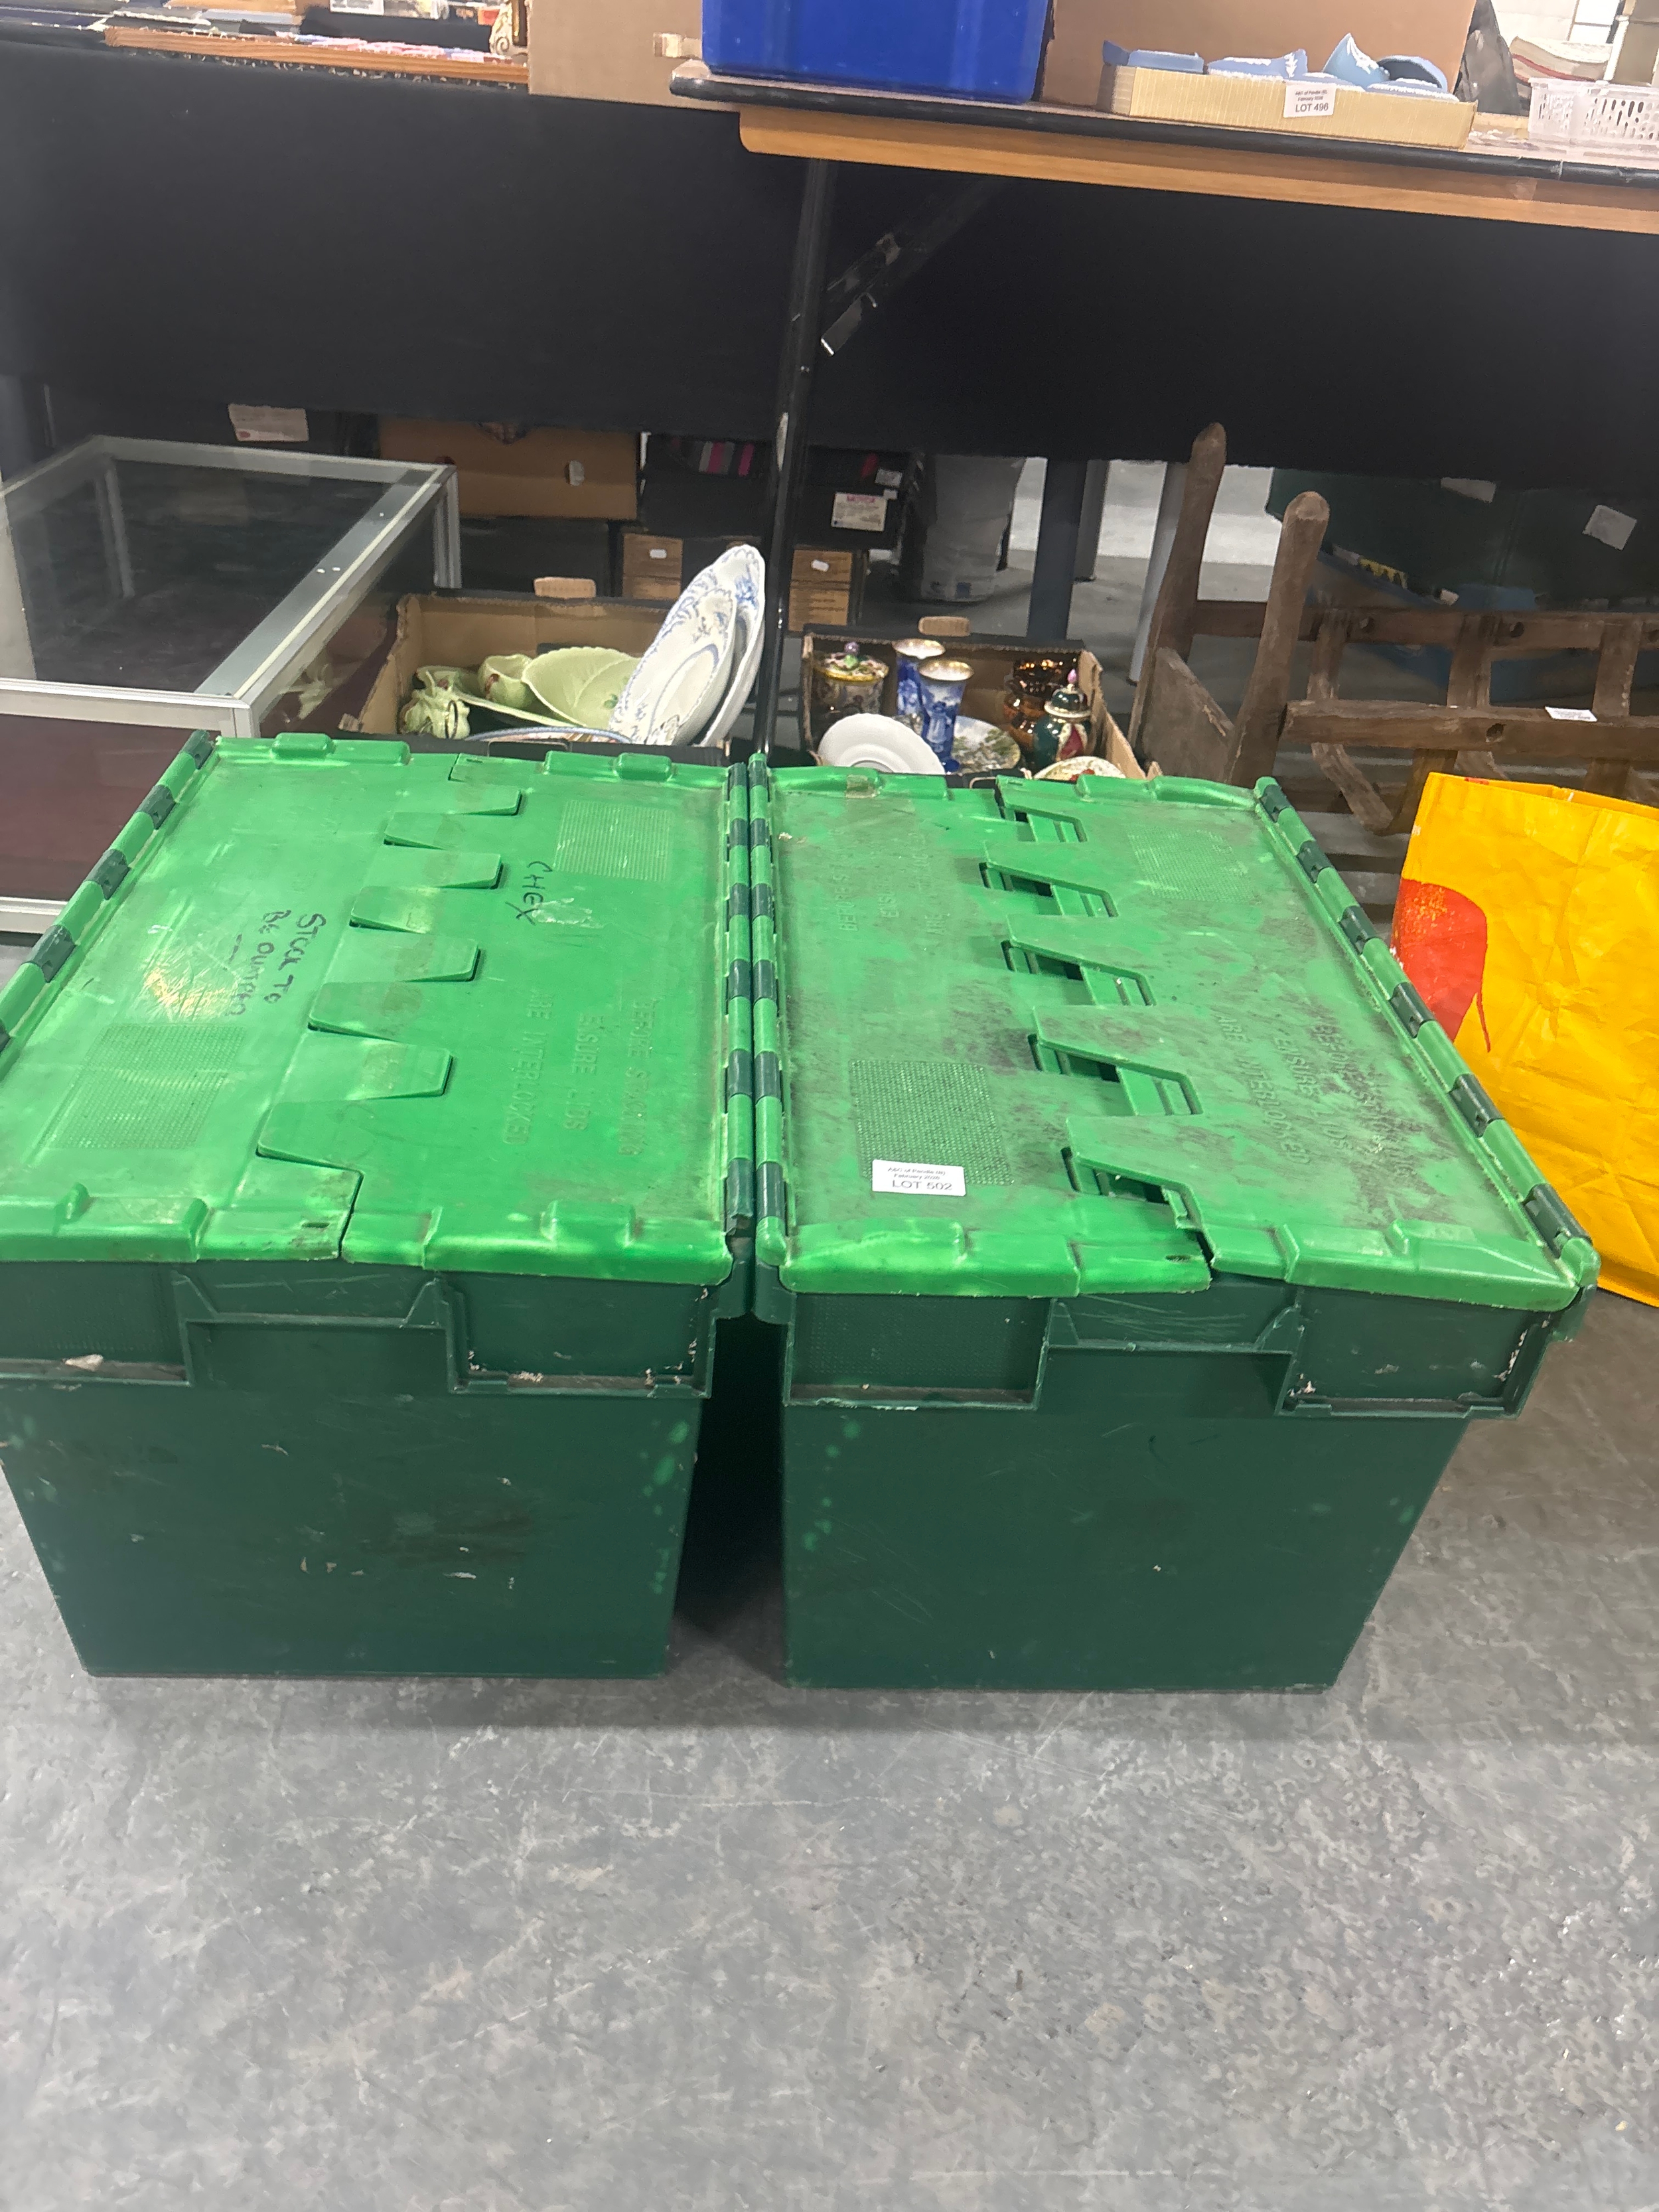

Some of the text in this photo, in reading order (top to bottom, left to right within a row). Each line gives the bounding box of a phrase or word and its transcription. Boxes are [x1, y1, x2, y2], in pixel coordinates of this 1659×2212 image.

[1295, 103, 1329, 112] LOT 496
[1273, 1034, 1324, 1097] ENSURE
[1216, 1015, 1312, 1165] ARE INTERLOCKED
[892, 1180, 922, 1189] LOT
